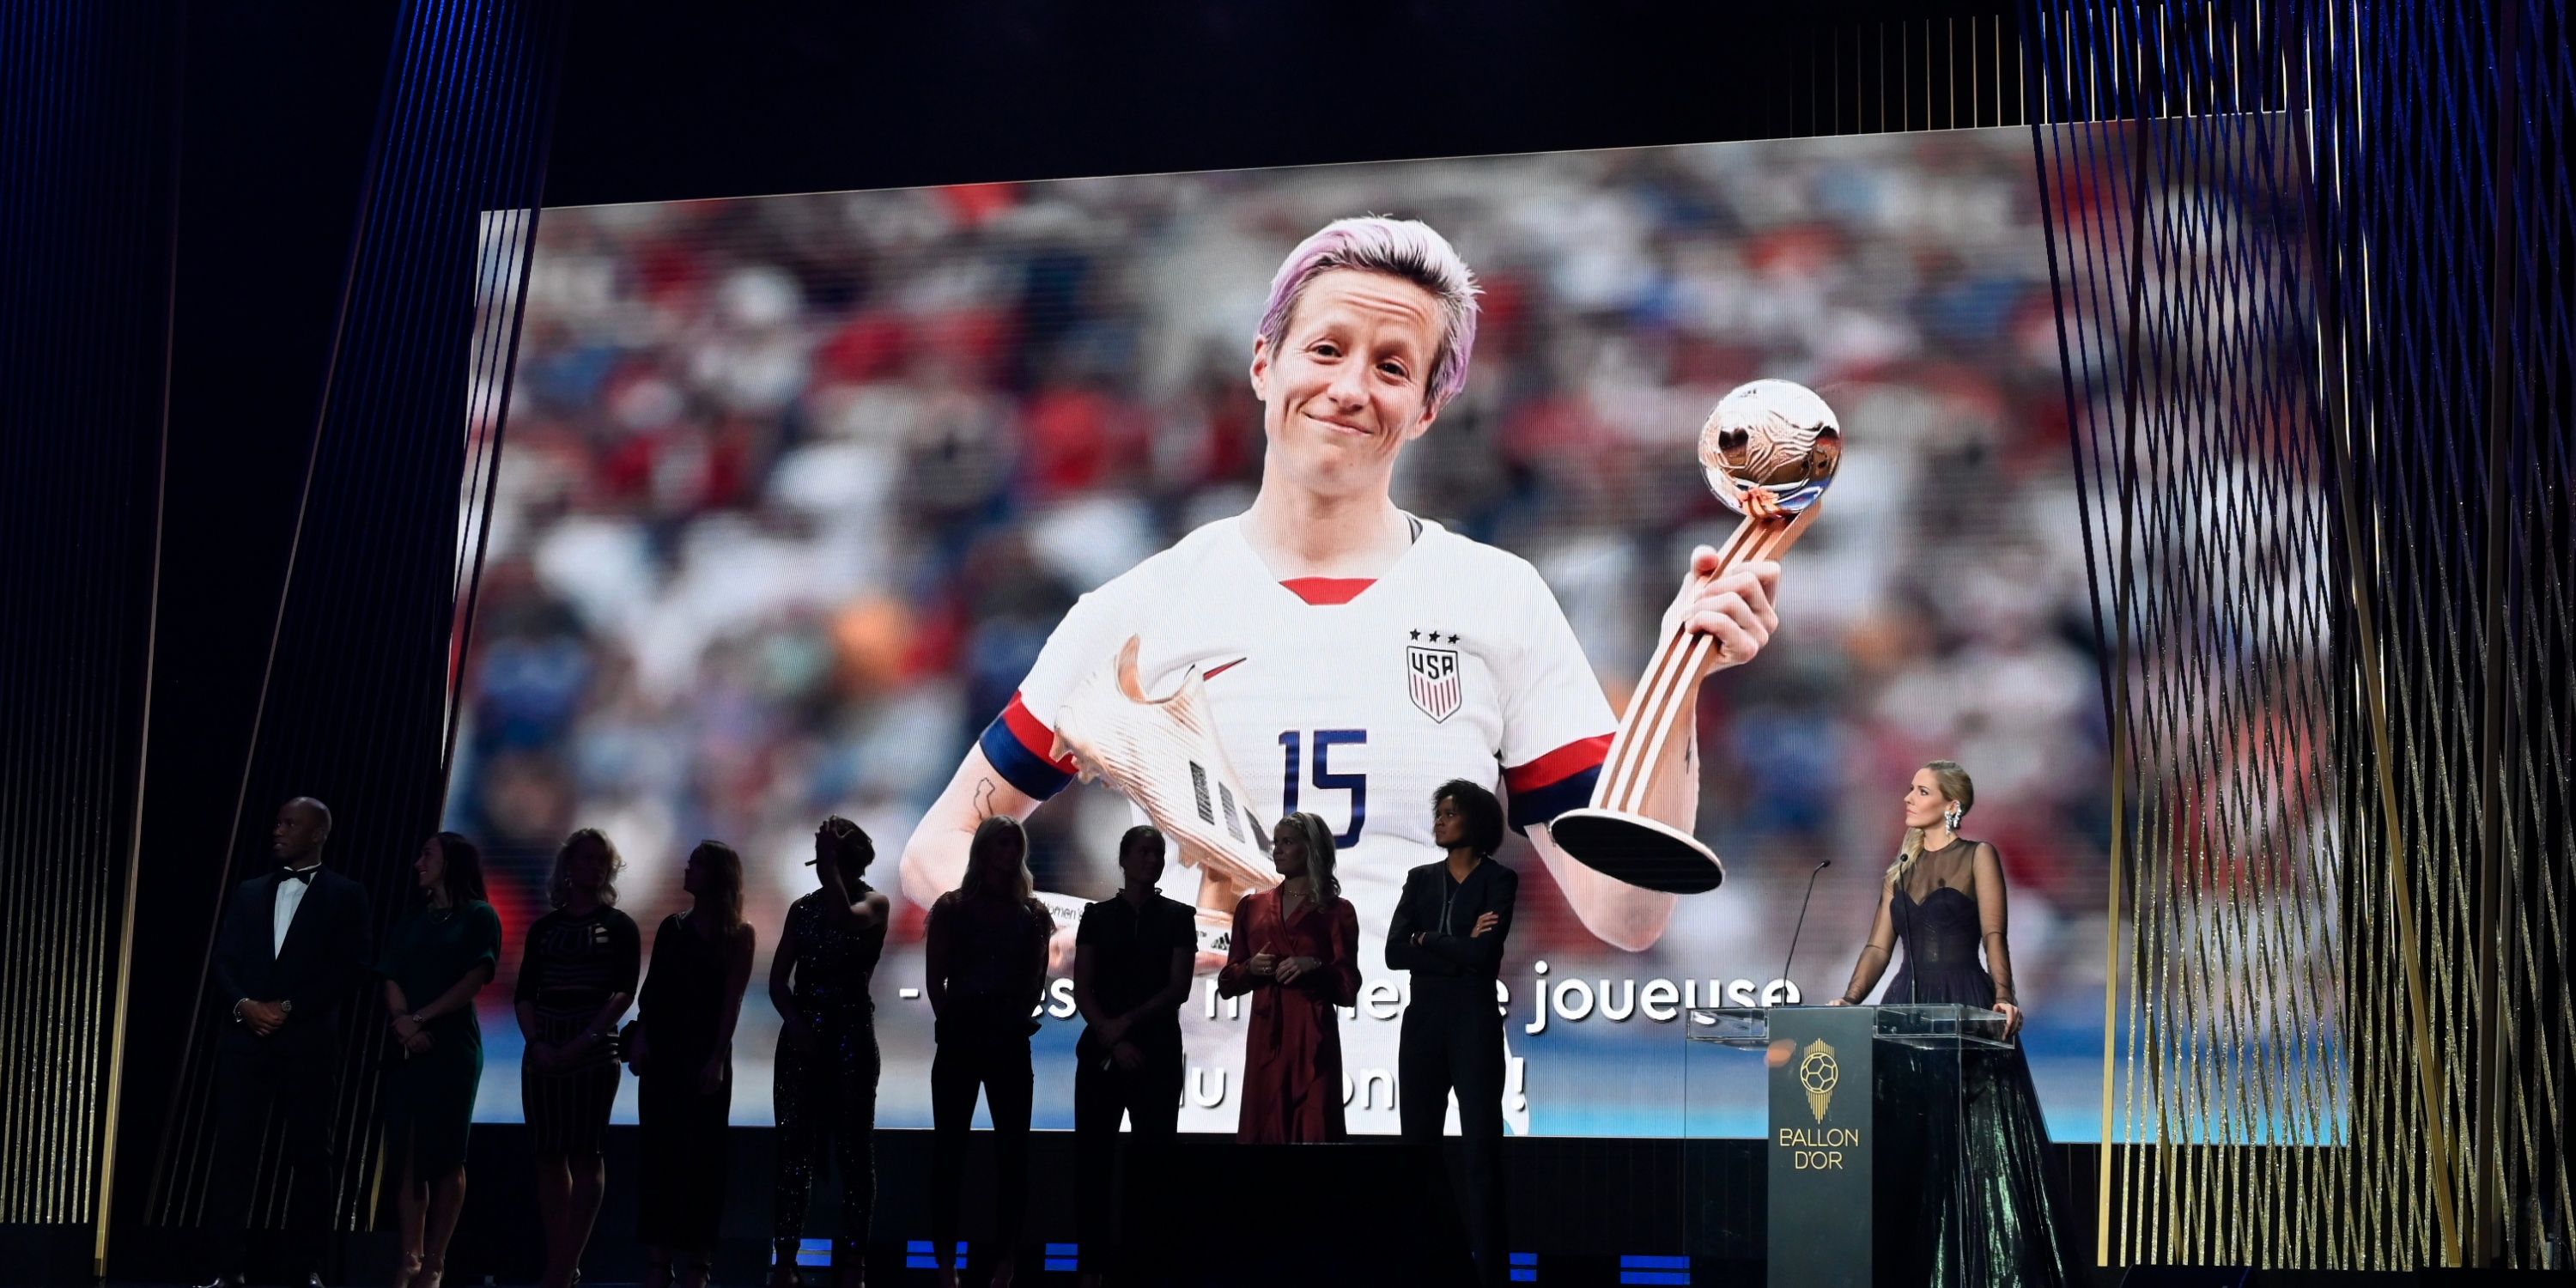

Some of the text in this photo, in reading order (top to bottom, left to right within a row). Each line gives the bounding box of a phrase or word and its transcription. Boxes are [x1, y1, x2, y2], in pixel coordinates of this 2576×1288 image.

[1412, 653, 1454, 679] USA
[1279, 729, 1366, 848] 15
[1525, 960, 1802, 1034] joueuse
[1180, 1052, 1225, 1108] u
[1780, 1128, 1859, 1146] BALLON
[1795, 1151, 1844, 1170] D'OR
